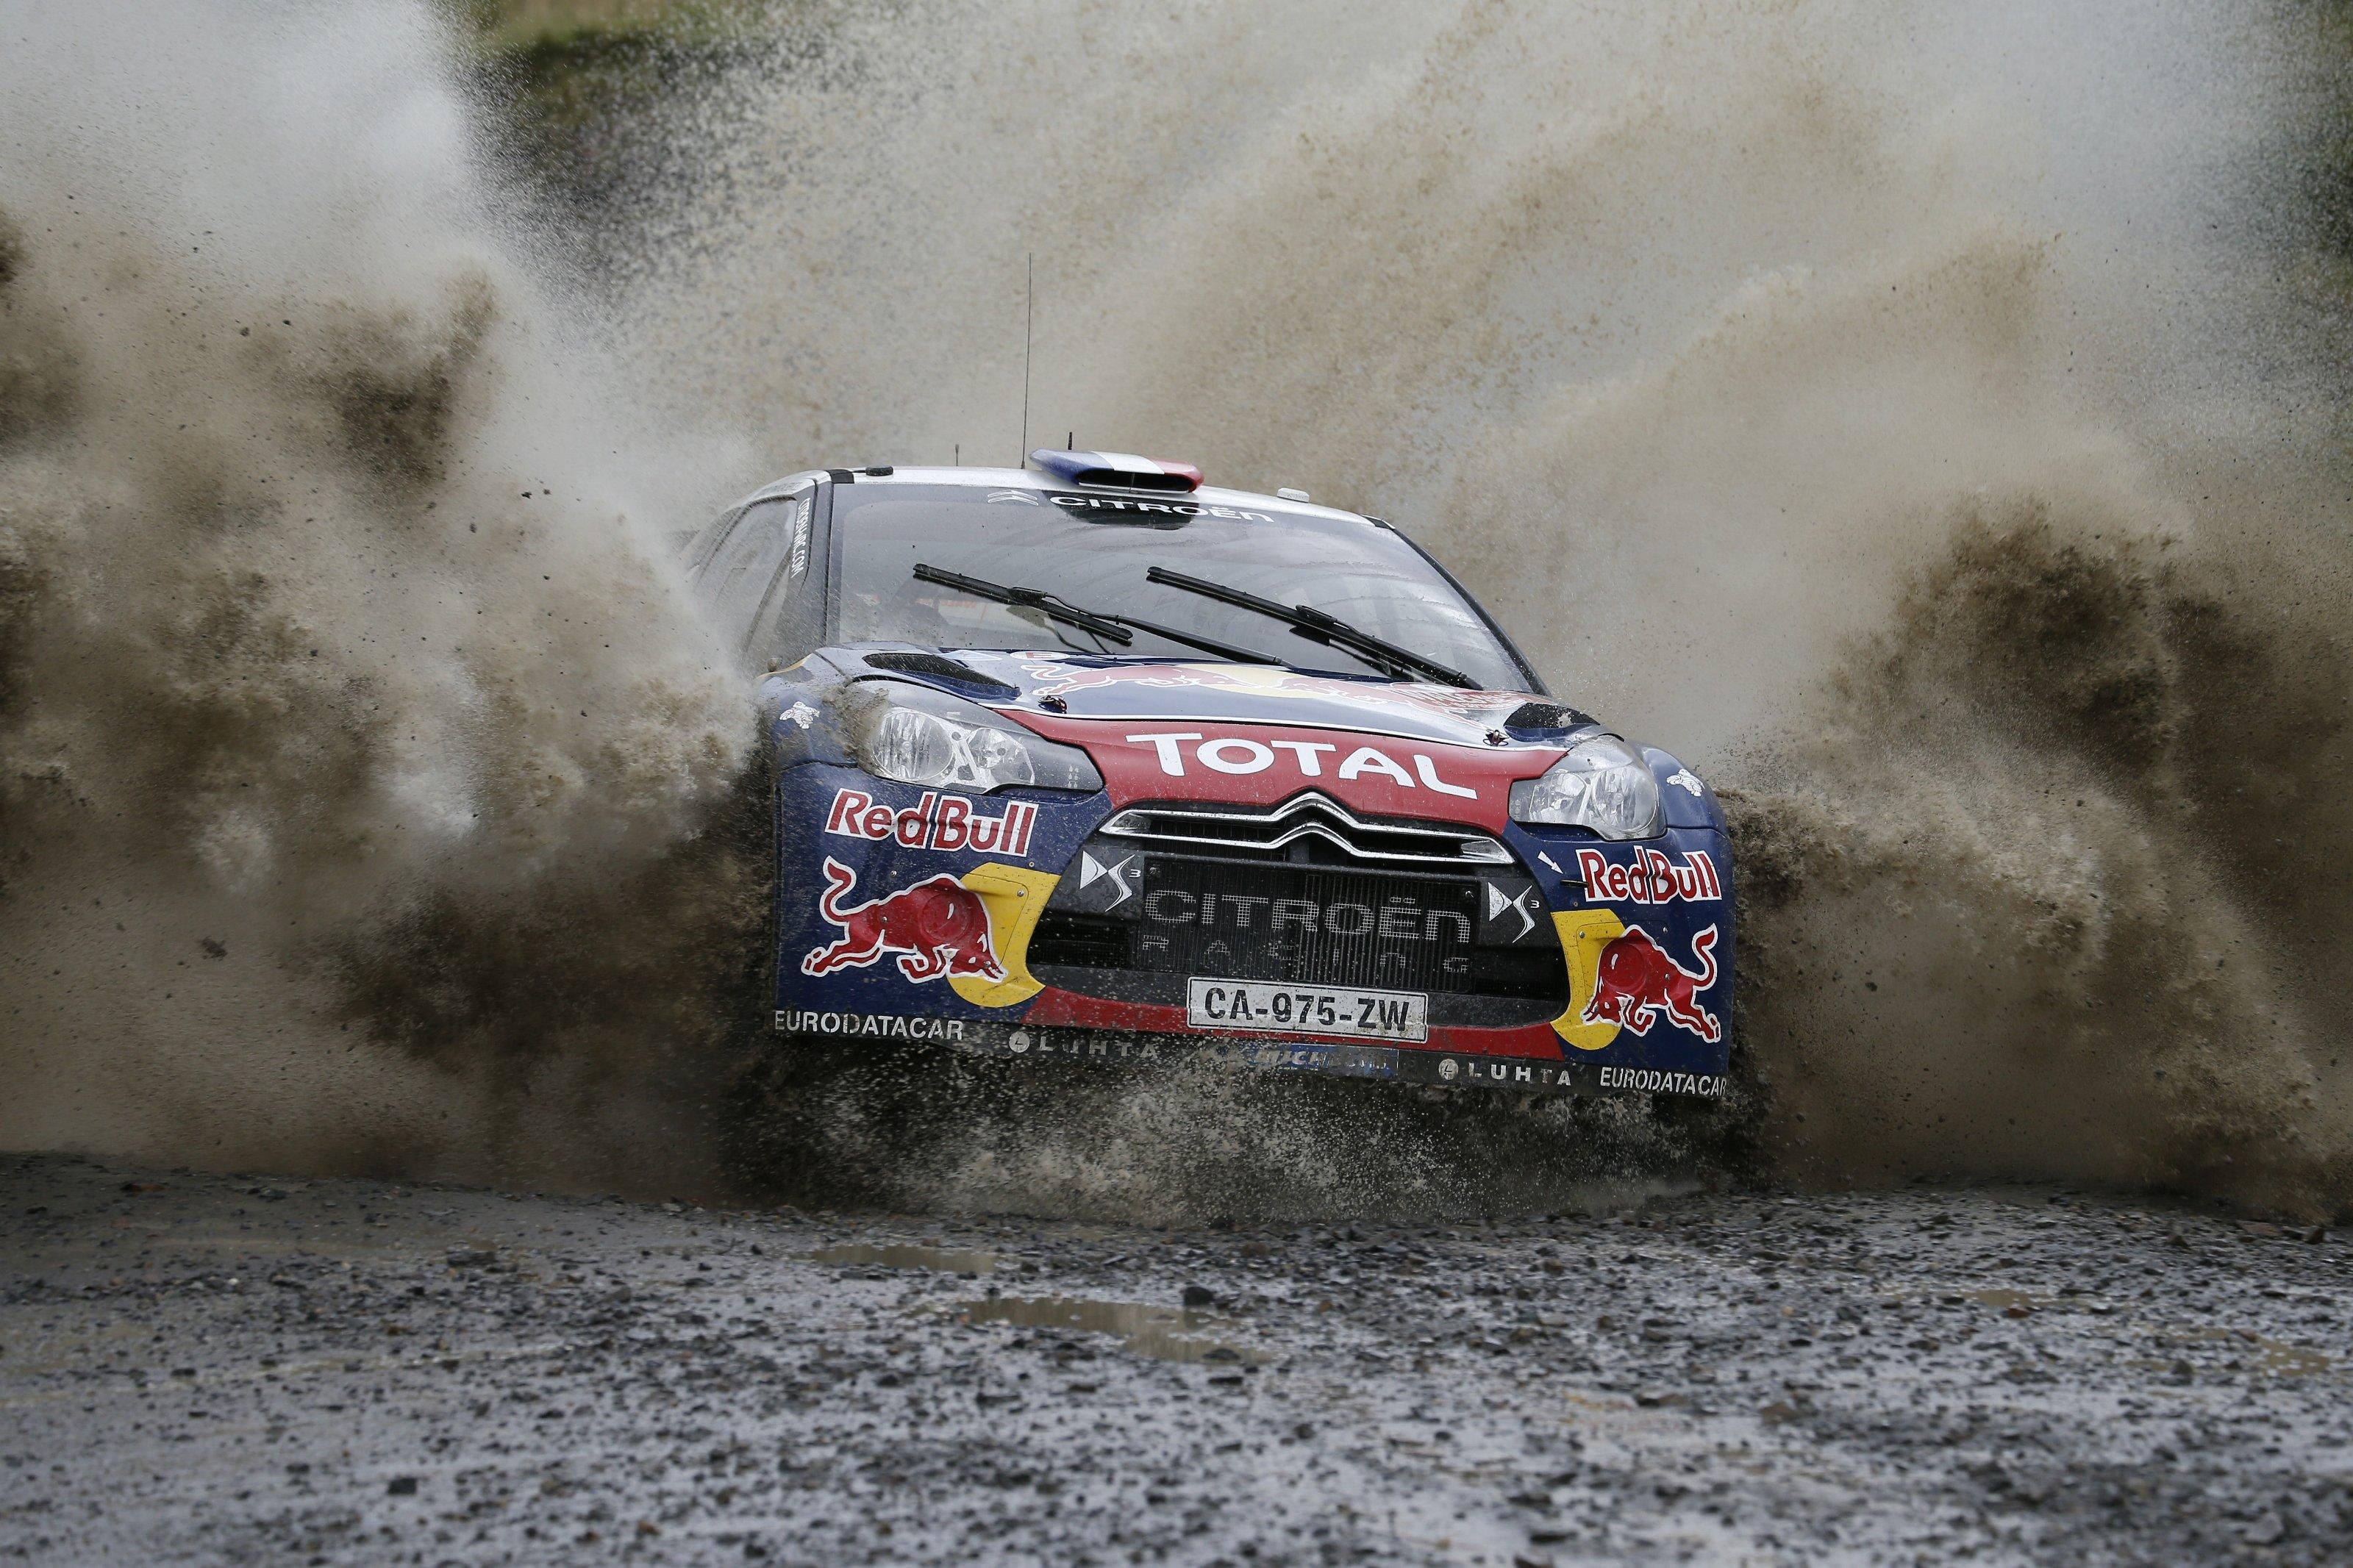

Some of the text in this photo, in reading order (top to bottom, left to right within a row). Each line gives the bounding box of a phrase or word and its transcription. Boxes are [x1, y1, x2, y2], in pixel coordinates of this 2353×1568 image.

[1126, 732, 1478, 800] TOTAL
[824, 787, 1039, 857] Red Bull
[1576, 845, 1722, 904] Red Bull
[775, 1010, 964, 1040] EURODATACAR
[1204, 987, 1410, 1031] CA-975-ZW
[1468, 1062, 1571, 1086] LUHTA
[1600, 1067, 1727, 1097] EURODATACAR
